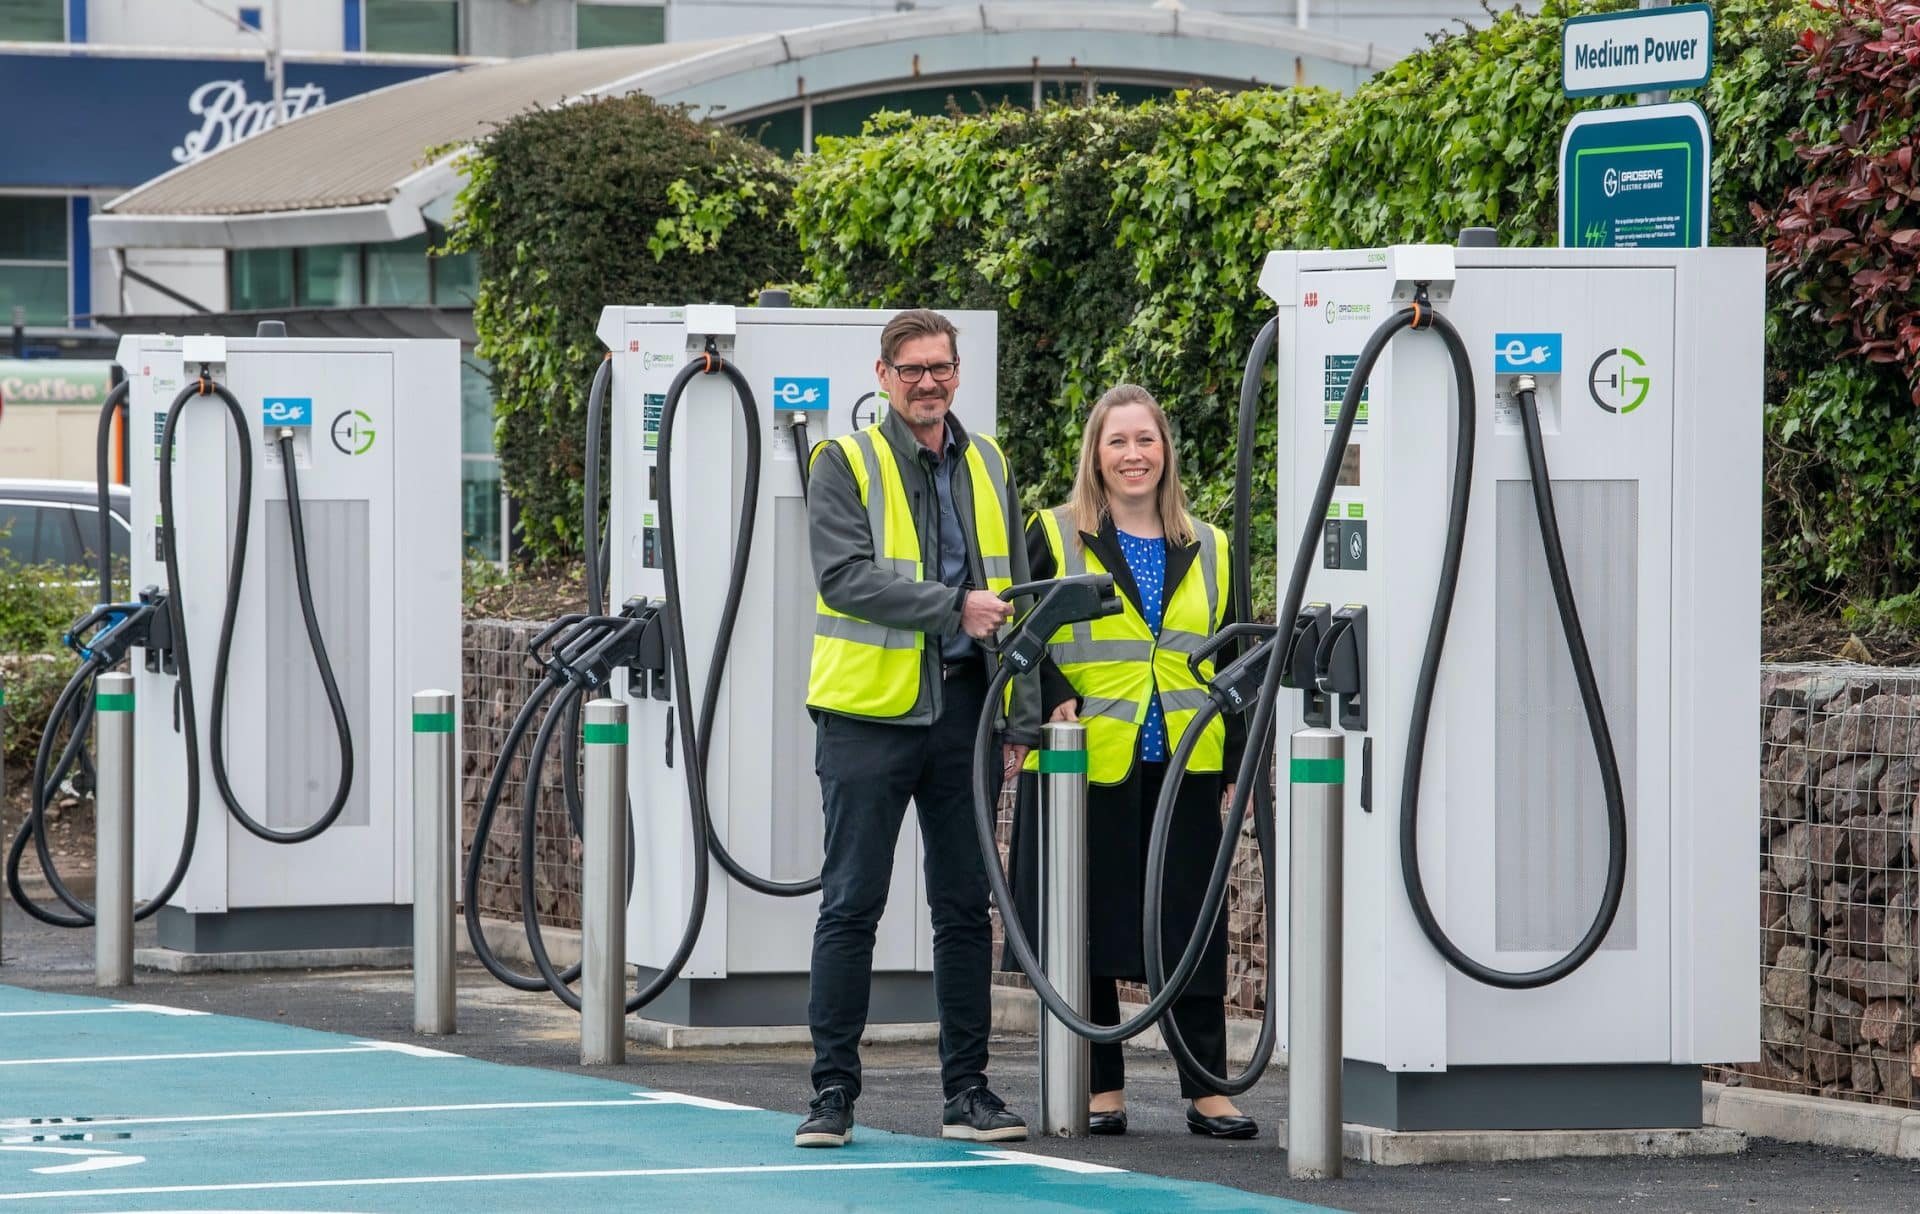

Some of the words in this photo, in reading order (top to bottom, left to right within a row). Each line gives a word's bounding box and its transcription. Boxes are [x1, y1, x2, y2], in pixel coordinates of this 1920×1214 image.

[1575, 38, 1639, 70] Medium
[1644, 37, 1698, 64] Power
[1621, 169, 1663, 182] GRIDSERVE
[1304, 292, 1318, 307] ABB
[1011, 650, 1028, 666] HPC
[585, 669, 598, 684] HPC
[1228, 686, 1243, 704] HPC
